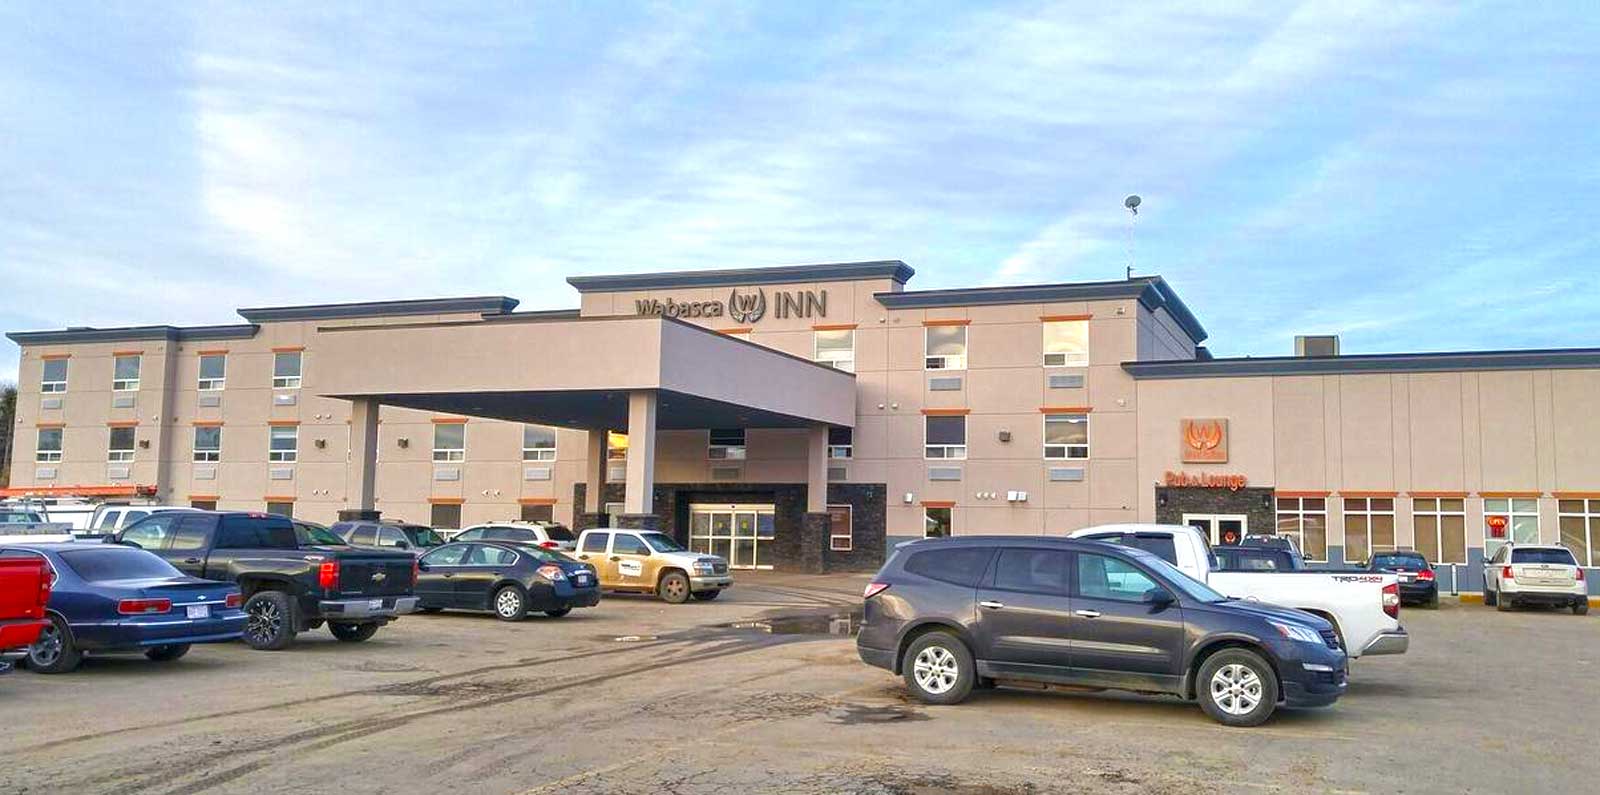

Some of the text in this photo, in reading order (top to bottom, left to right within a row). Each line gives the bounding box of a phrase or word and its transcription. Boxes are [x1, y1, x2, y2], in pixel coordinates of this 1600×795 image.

[635, 297, 724, 317] Wabasca
[774, 289, 827, 319] INN
[1165, 470, 1185, 487] Pub
[1201, 471, 1248, 492] Lounge
